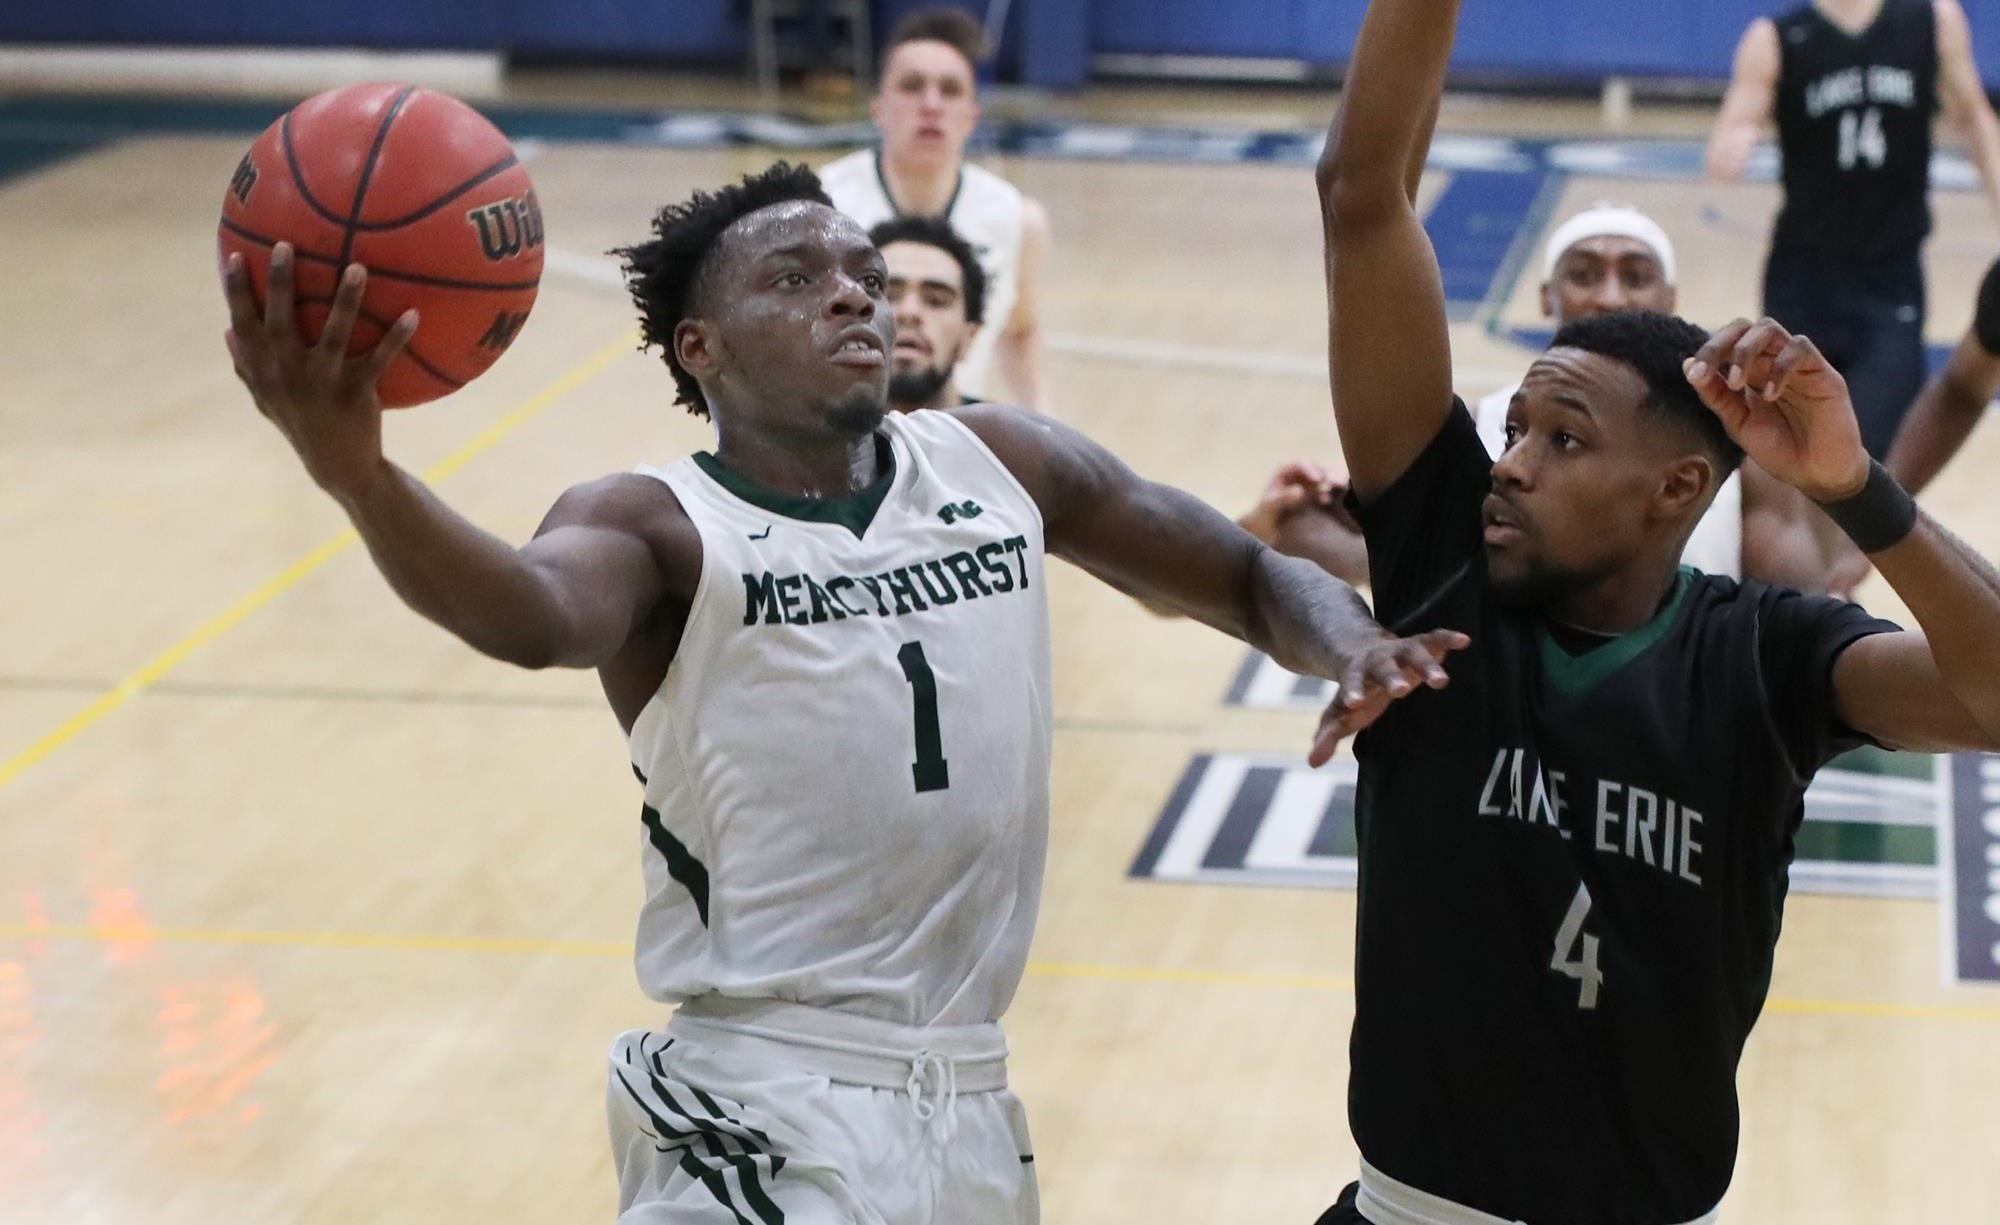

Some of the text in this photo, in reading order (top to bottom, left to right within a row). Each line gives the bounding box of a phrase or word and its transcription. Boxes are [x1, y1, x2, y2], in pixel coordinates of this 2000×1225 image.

[1837, 106, 1887, 170] 14
[897, 640, 949, 793] 1
[1596, 778, 1703, 886] ERIE
[1550, 879, 1604, 1010] 4
